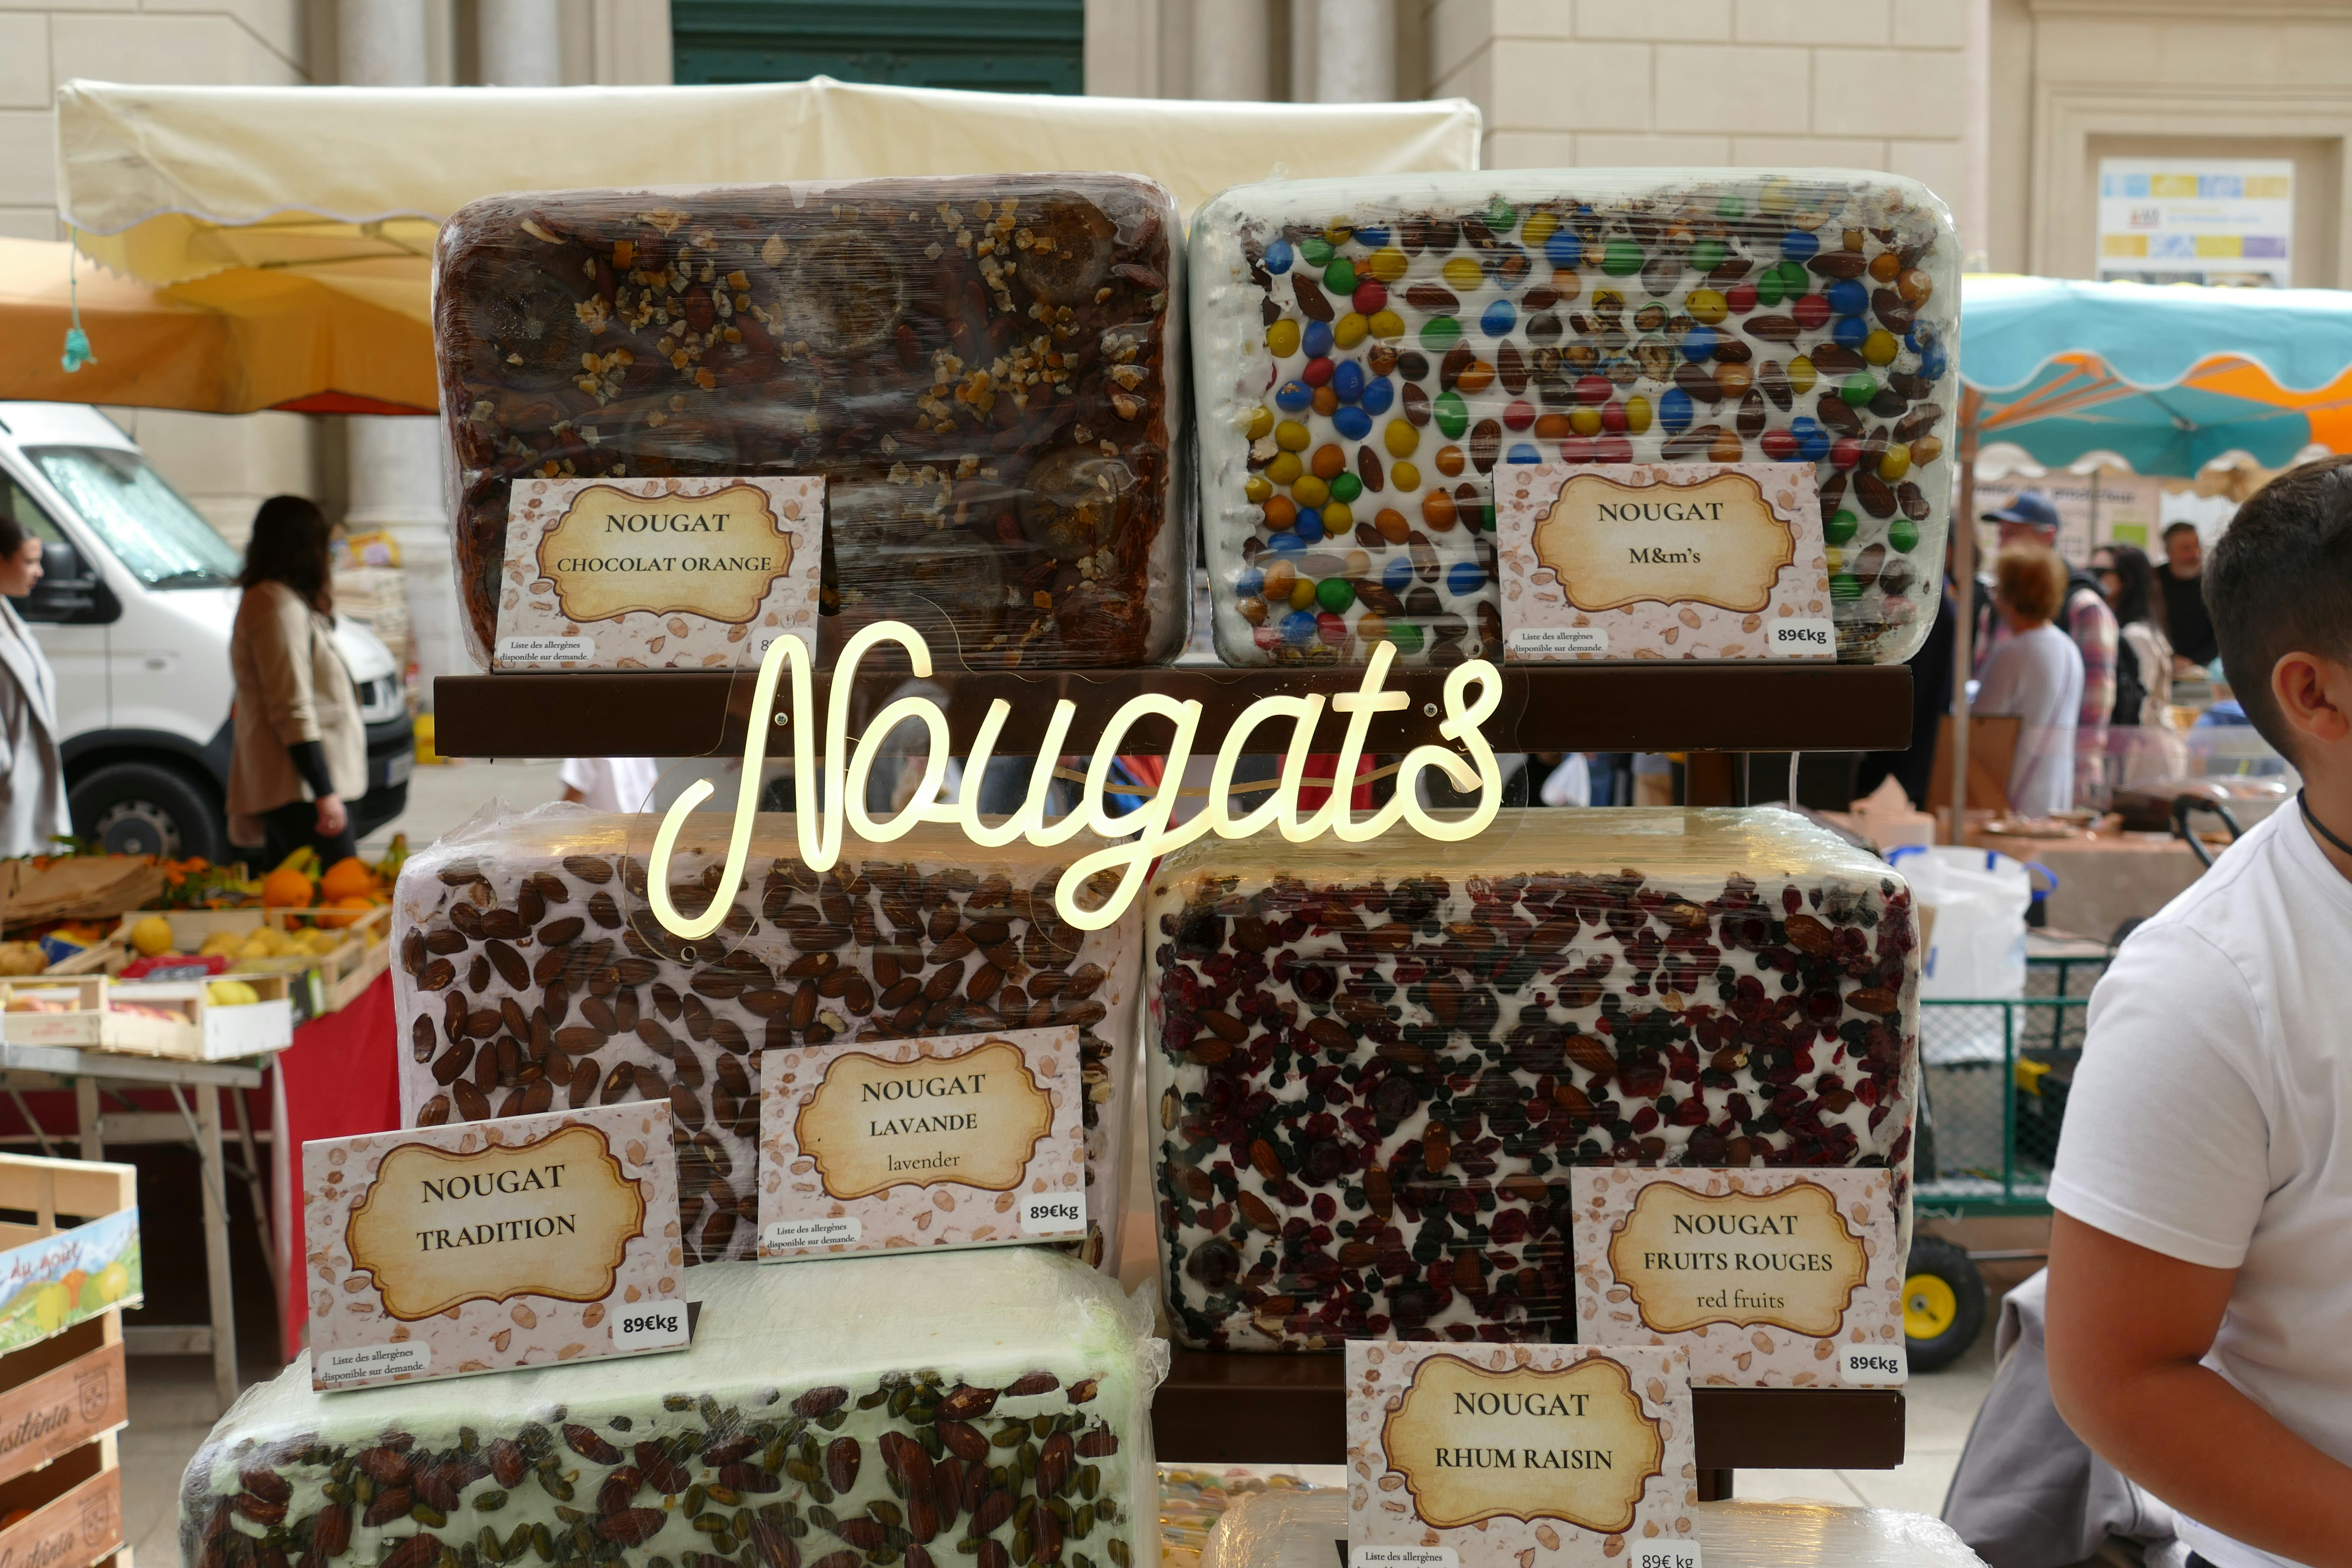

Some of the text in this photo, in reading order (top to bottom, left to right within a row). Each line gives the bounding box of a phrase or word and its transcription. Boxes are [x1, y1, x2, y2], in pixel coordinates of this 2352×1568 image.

[1598, 502, 1723, 521] NOUGAT
[605, 514, 730, 532] NOUGAT
[557, 557, 771, 572] CHOCOLAT ORANGE
[1557, 632, 1593, 642] allergènes
[1778, 629, 1826, 644] 89€kg
[544, 641, 580, 651] allergènes
[1513, 645, 1552, 653] disponible
[500, 653, 538, 662] disponible
[646, 621, 1503, 940] Nougats
[861, 1074, 986, 1102] NOUGAT
[871, 1114, 977, 1136] LAVANDE
[888, 1151, 960, 1171] lavender
[421, 1164, 565, 1203] NOUGAT
[1030, 1204, 1078, 1219] 89€kg
[416, 1214, 576, 1251] TRADITION
[811, 1223, 847, 1234] allergènes
[1673, 1215, 1798, 1234] NOUGAT
[767, 1239, 805, 1249] disponible
[821, 1234, 856, 1244] demande.
[1645, 1253, 1832, 1271] FRUITS ROUGES
[1697, 1289, 1784, 1308] red fruits
[623, 1314, 678, 1333] 89€kg
[333, 1348, 413, 1365] Liste des allergènes
[1850, 1356, 1898, 1373] 89€kg
[322, 1369, 366, 1383] disponible
[384, 1361, 425, 1374] demande.
[1454, 1392, 1589, 1416] NOUGAT
[1435, 1448, 1612, 1470] RHUM RAISIN
[1366, 1551, 1442, 1564] Liste des allergènes
